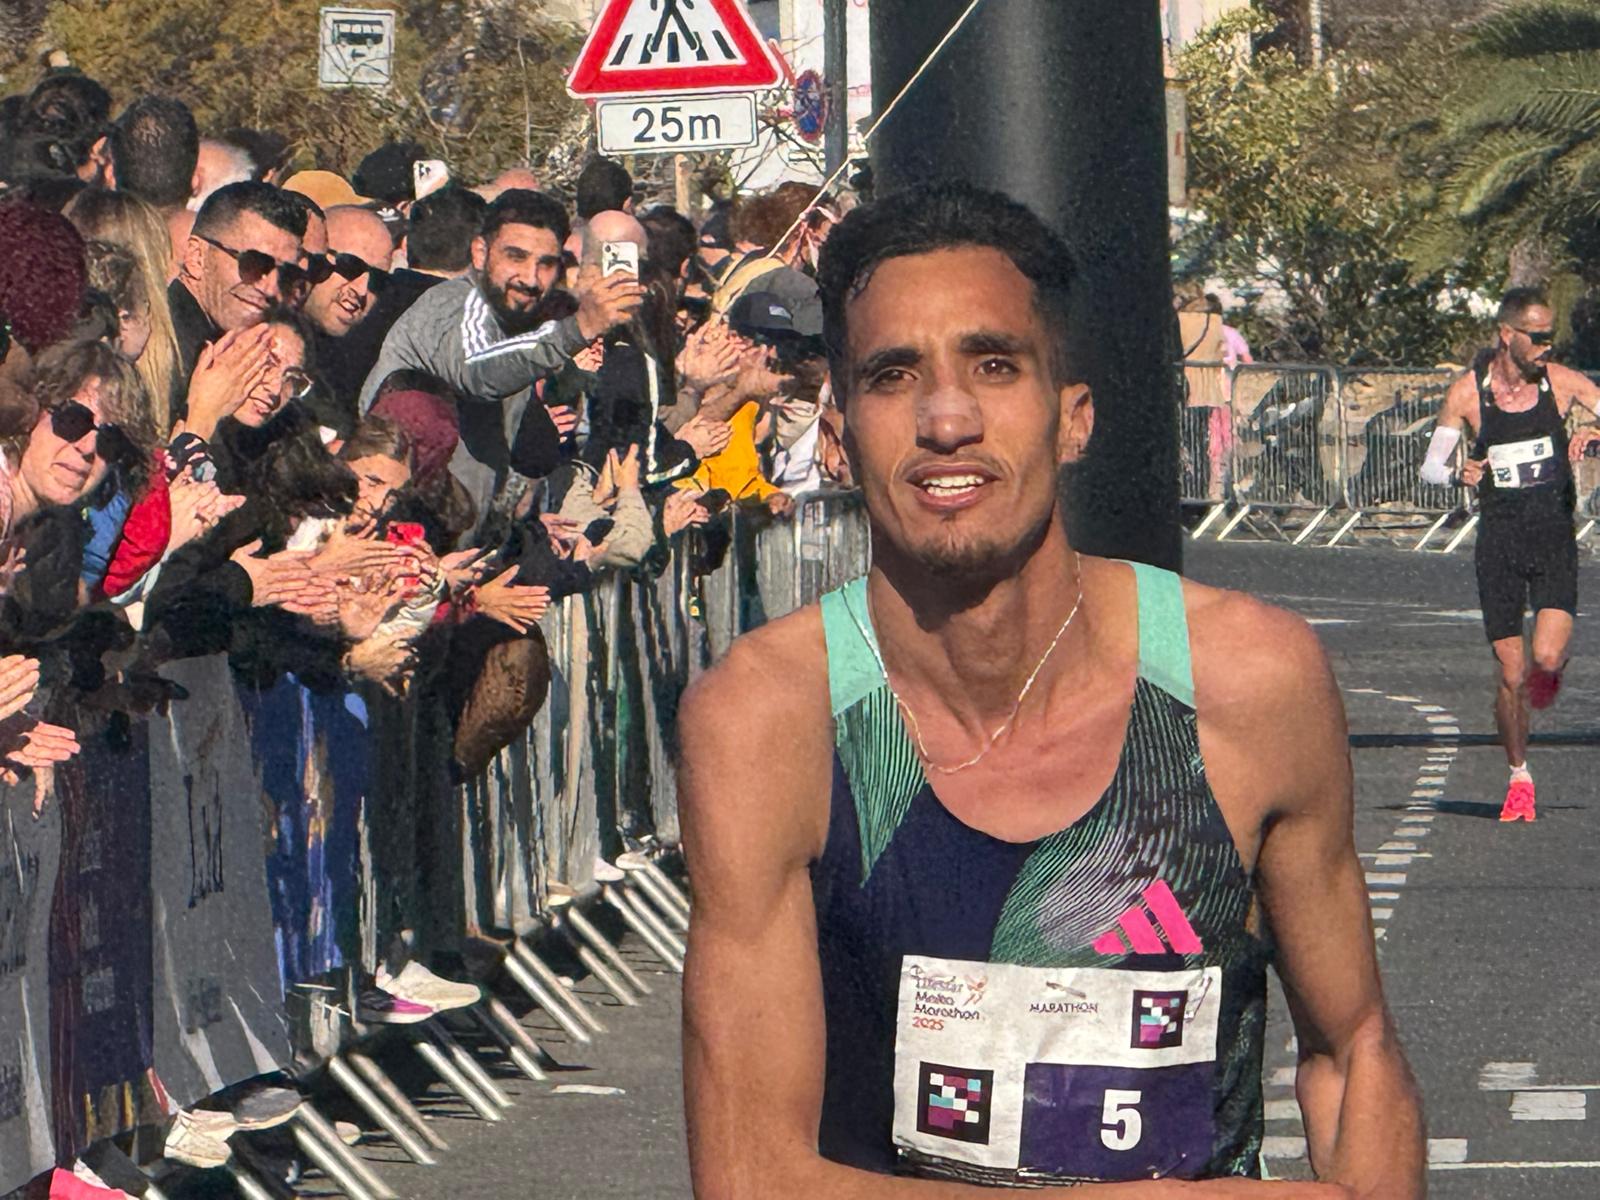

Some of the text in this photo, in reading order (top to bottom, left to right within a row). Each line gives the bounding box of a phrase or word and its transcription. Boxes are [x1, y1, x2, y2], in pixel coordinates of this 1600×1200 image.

[632, 106, 721, 143] 25m
[914, 1003, 980, 1020] Marathon
[1029, 1002, 1099, 1014] MARATHON
[912, 1016, 945, 1031] 2025
[1100, 1089, 1142, 1151] 5
